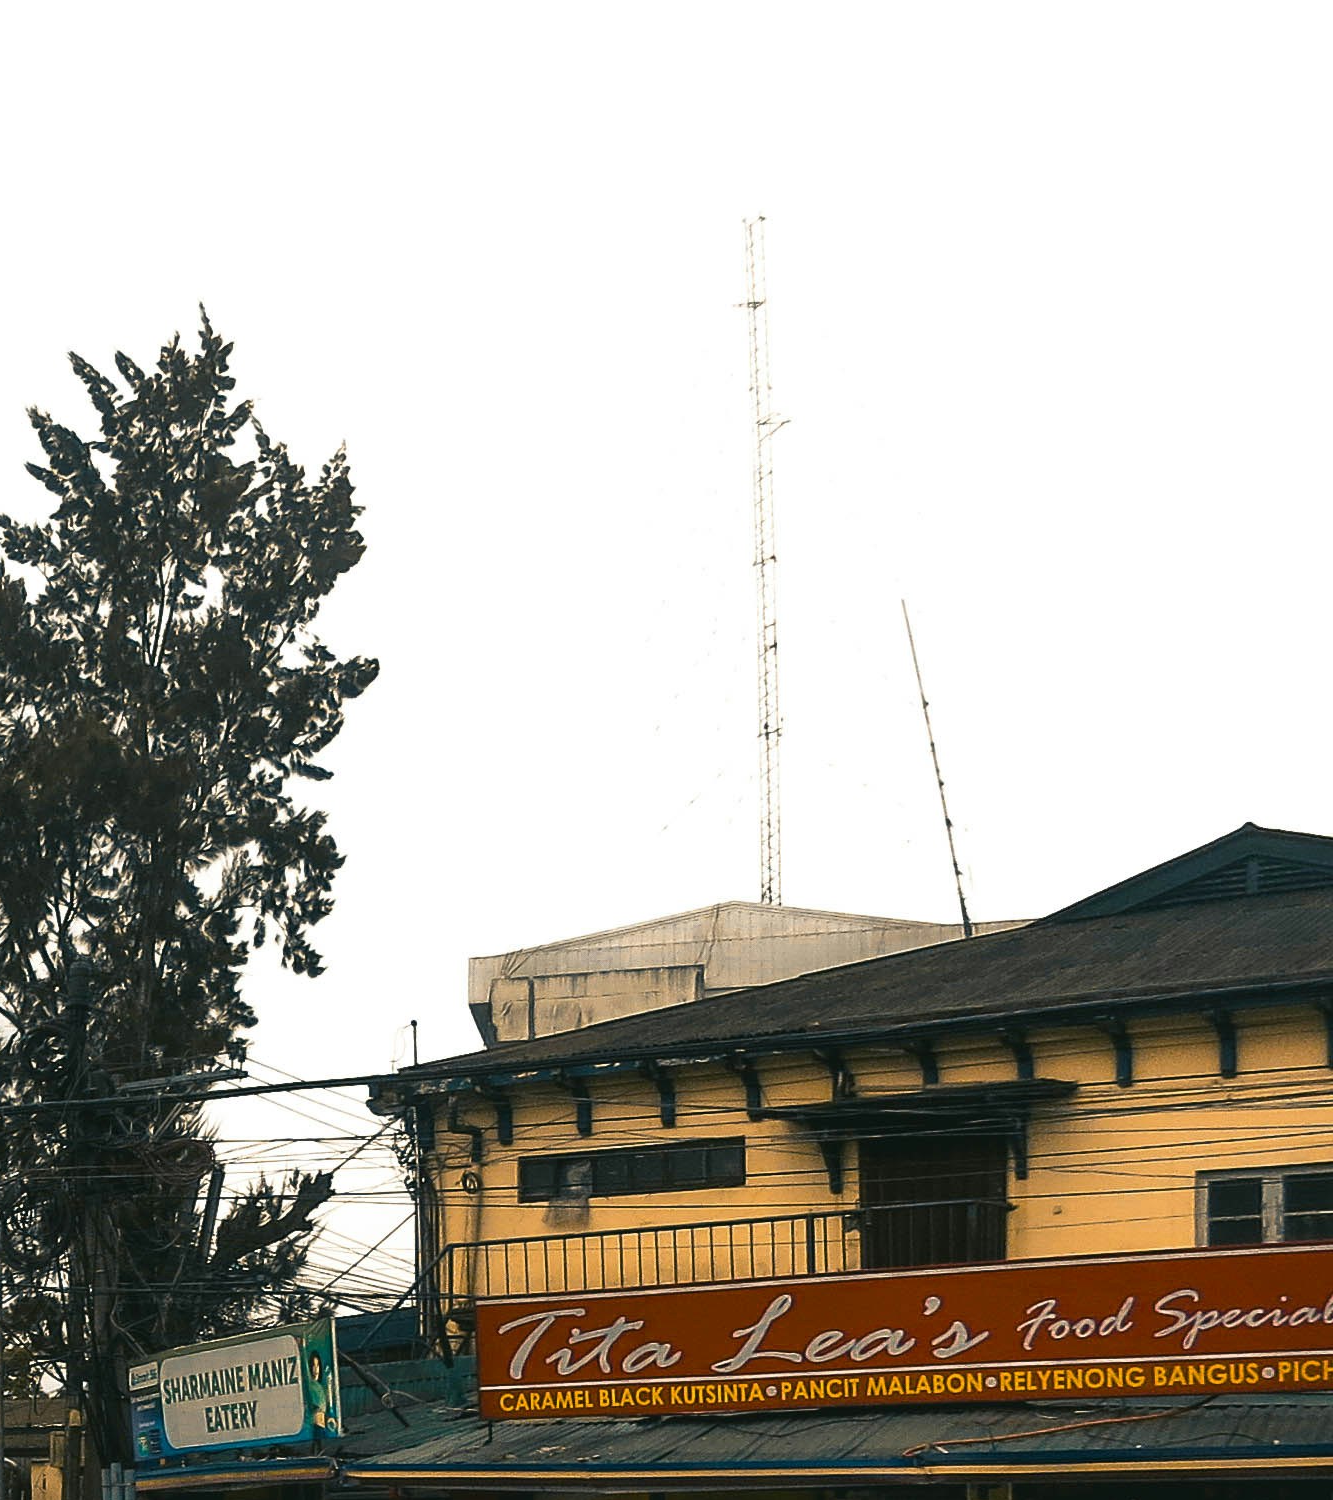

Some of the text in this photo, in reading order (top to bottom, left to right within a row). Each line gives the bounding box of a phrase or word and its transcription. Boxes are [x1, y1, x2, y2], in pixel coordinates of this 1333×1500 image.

[498, 1308, 682, 1380] Tita
[711, 1294, 990, 1374] Lea's
[1017, 1296, 1135, 1350] Food
[161, 1365, 245, 1404] SHARMAINE
[248, 1356, 300, 1391] MANIZ
[500, 1389, 594, 1412] CARAMEL
[599, 1386, 664, 1408] BLACK
[670, 1383, 764, 1405] KUTSINTA
[781, 1378, 860, 1401] PANCIT
[866, 1372, 983, 1397] MALABON
[1000, 1364, 1145, 1392] RELYENONG
[1154, 1361, 1259, 1387] BANGUS
[205, 1400, 258, 1433] EATERY
